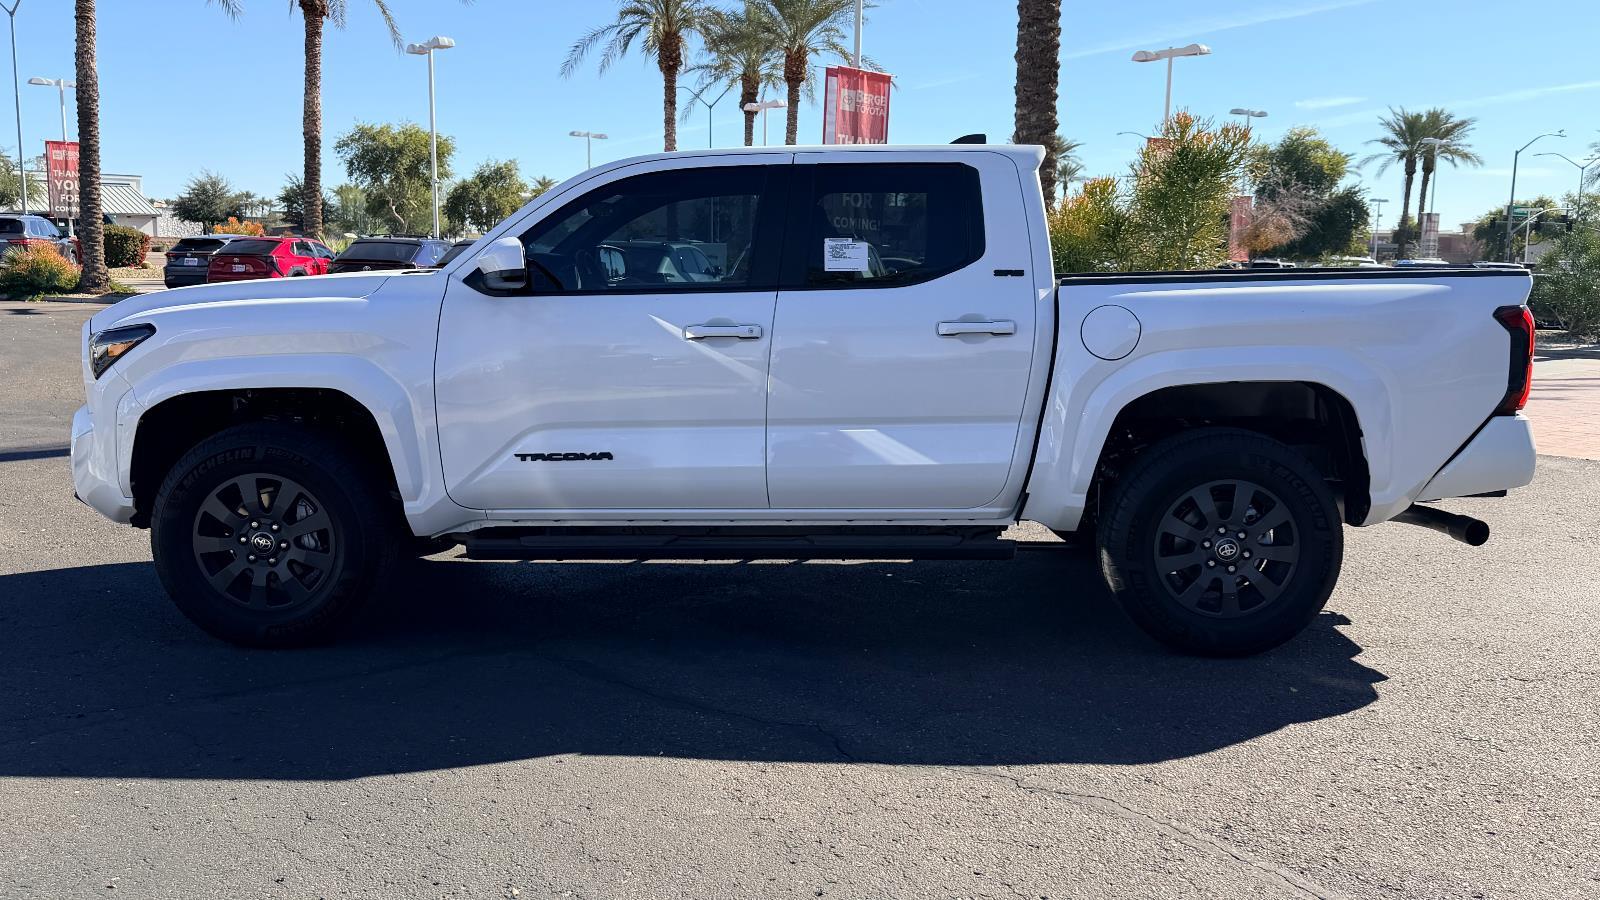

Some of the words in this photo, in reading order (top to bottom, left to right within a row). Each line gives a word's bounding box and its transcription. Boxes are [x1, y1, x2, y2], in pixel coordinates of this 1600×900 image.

[856, 90, 886, 106] BERGE
[856, 104, 885, 116] TOYOTA
[53, 169, 80, 178] THAN
[842, 193, 873, 208] FOR
[833, 216, 881, 231] COMING!
[513, 452, 613, 461] TACOMA
[182, 448, 254, 489] MICHELIN
